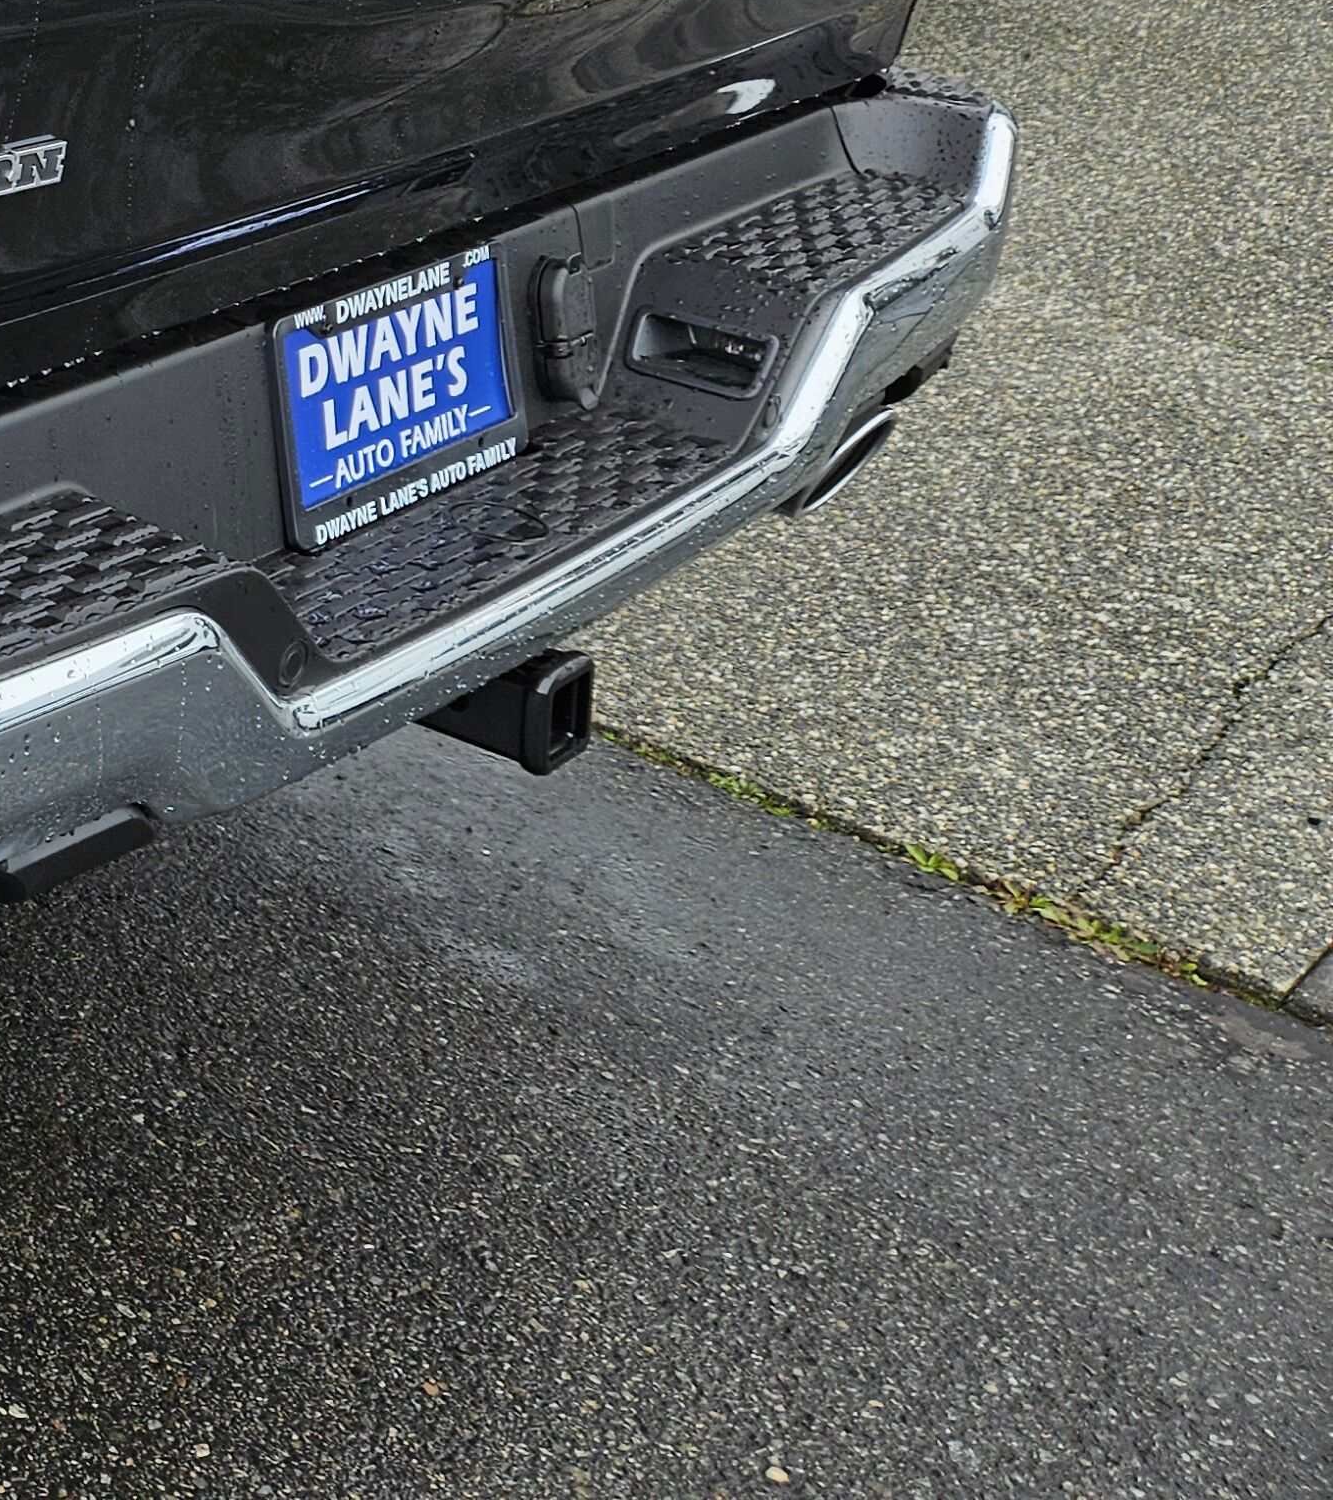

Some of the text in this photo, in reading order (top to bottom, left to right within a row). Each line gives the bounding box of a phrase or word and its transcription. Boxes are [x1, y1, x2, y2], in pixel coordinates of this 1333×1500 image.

[298, 282, 480, 398] DWAYNE
[336, 261, 451, 325] DWAYNELANE
[323, 346, 468, 451] LANE'S
[335, 403, 469, 490] AUTO FAMILY
[315, 436, 517, 546] DWAYNE LANE'S AUTO FAMILY
